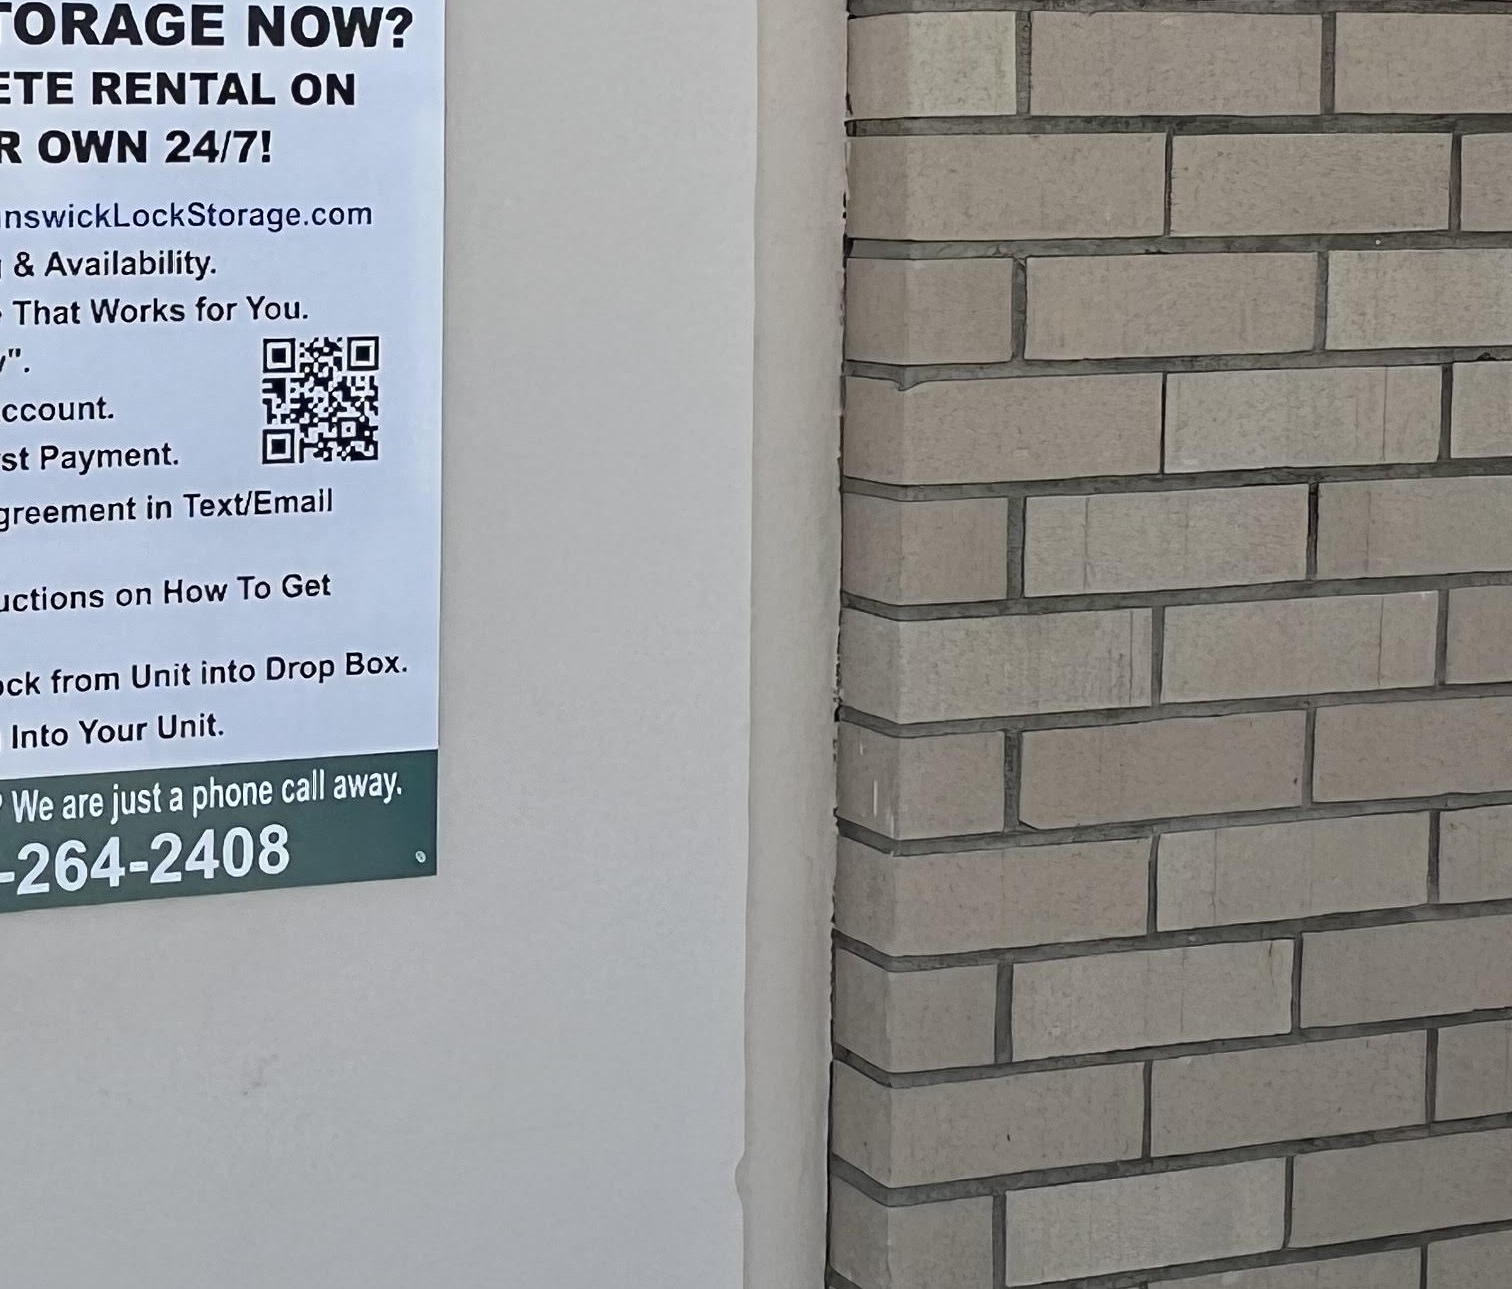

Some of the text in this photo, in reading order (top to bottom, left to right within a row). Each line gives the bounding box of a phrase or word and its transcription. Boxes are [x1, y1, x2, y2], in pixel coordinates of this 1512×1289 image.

[248, 5, 412, 48] NOW?
[93, 72, 275, 105] RENTAL
[291, 73, 354, 105] ON
[38, 130, 147, 163] OWN
[165, 130, 270, 163] 24/7!
[14, 252, 34, 277] &
[45, 250, 216, 281] Availability.
[13, 300, 80, 325] That
[91, 298, 185, 323] Works
[195, 296, 237, 321] for
[246, 296, 308, 320] You.
[41, 443, 178, 475] Payment.
[147, 495, 171, 519] in
[183, 488, 332, 517] Text/Email
[117, 588, 151, 606] on
[165, 579, 227, 604] How
[237, 576, 270, 600] To
[282, 574, 331, 598] Get
[51, 669, 119, 693] from
[132, 663, 190, 688] Unit
[202, 660, 255, 684] into
[267, 657, 334, 683] Drop
[346, 652, 407, 675] Box.
[13, 725, 68, 749] Into
[79, 719, 147, 744] Your
[158, 713, 223, 739] Unit.
[12, 790, 53, 823] We
[63, 793, 103, 819] are
[111, 783, 161, 825] just
[170, 787, 183, 811] a
[193, 777, 272, 818] phone
[282, 769, 324, 803] call
[334, 772, 401, 804] away.
